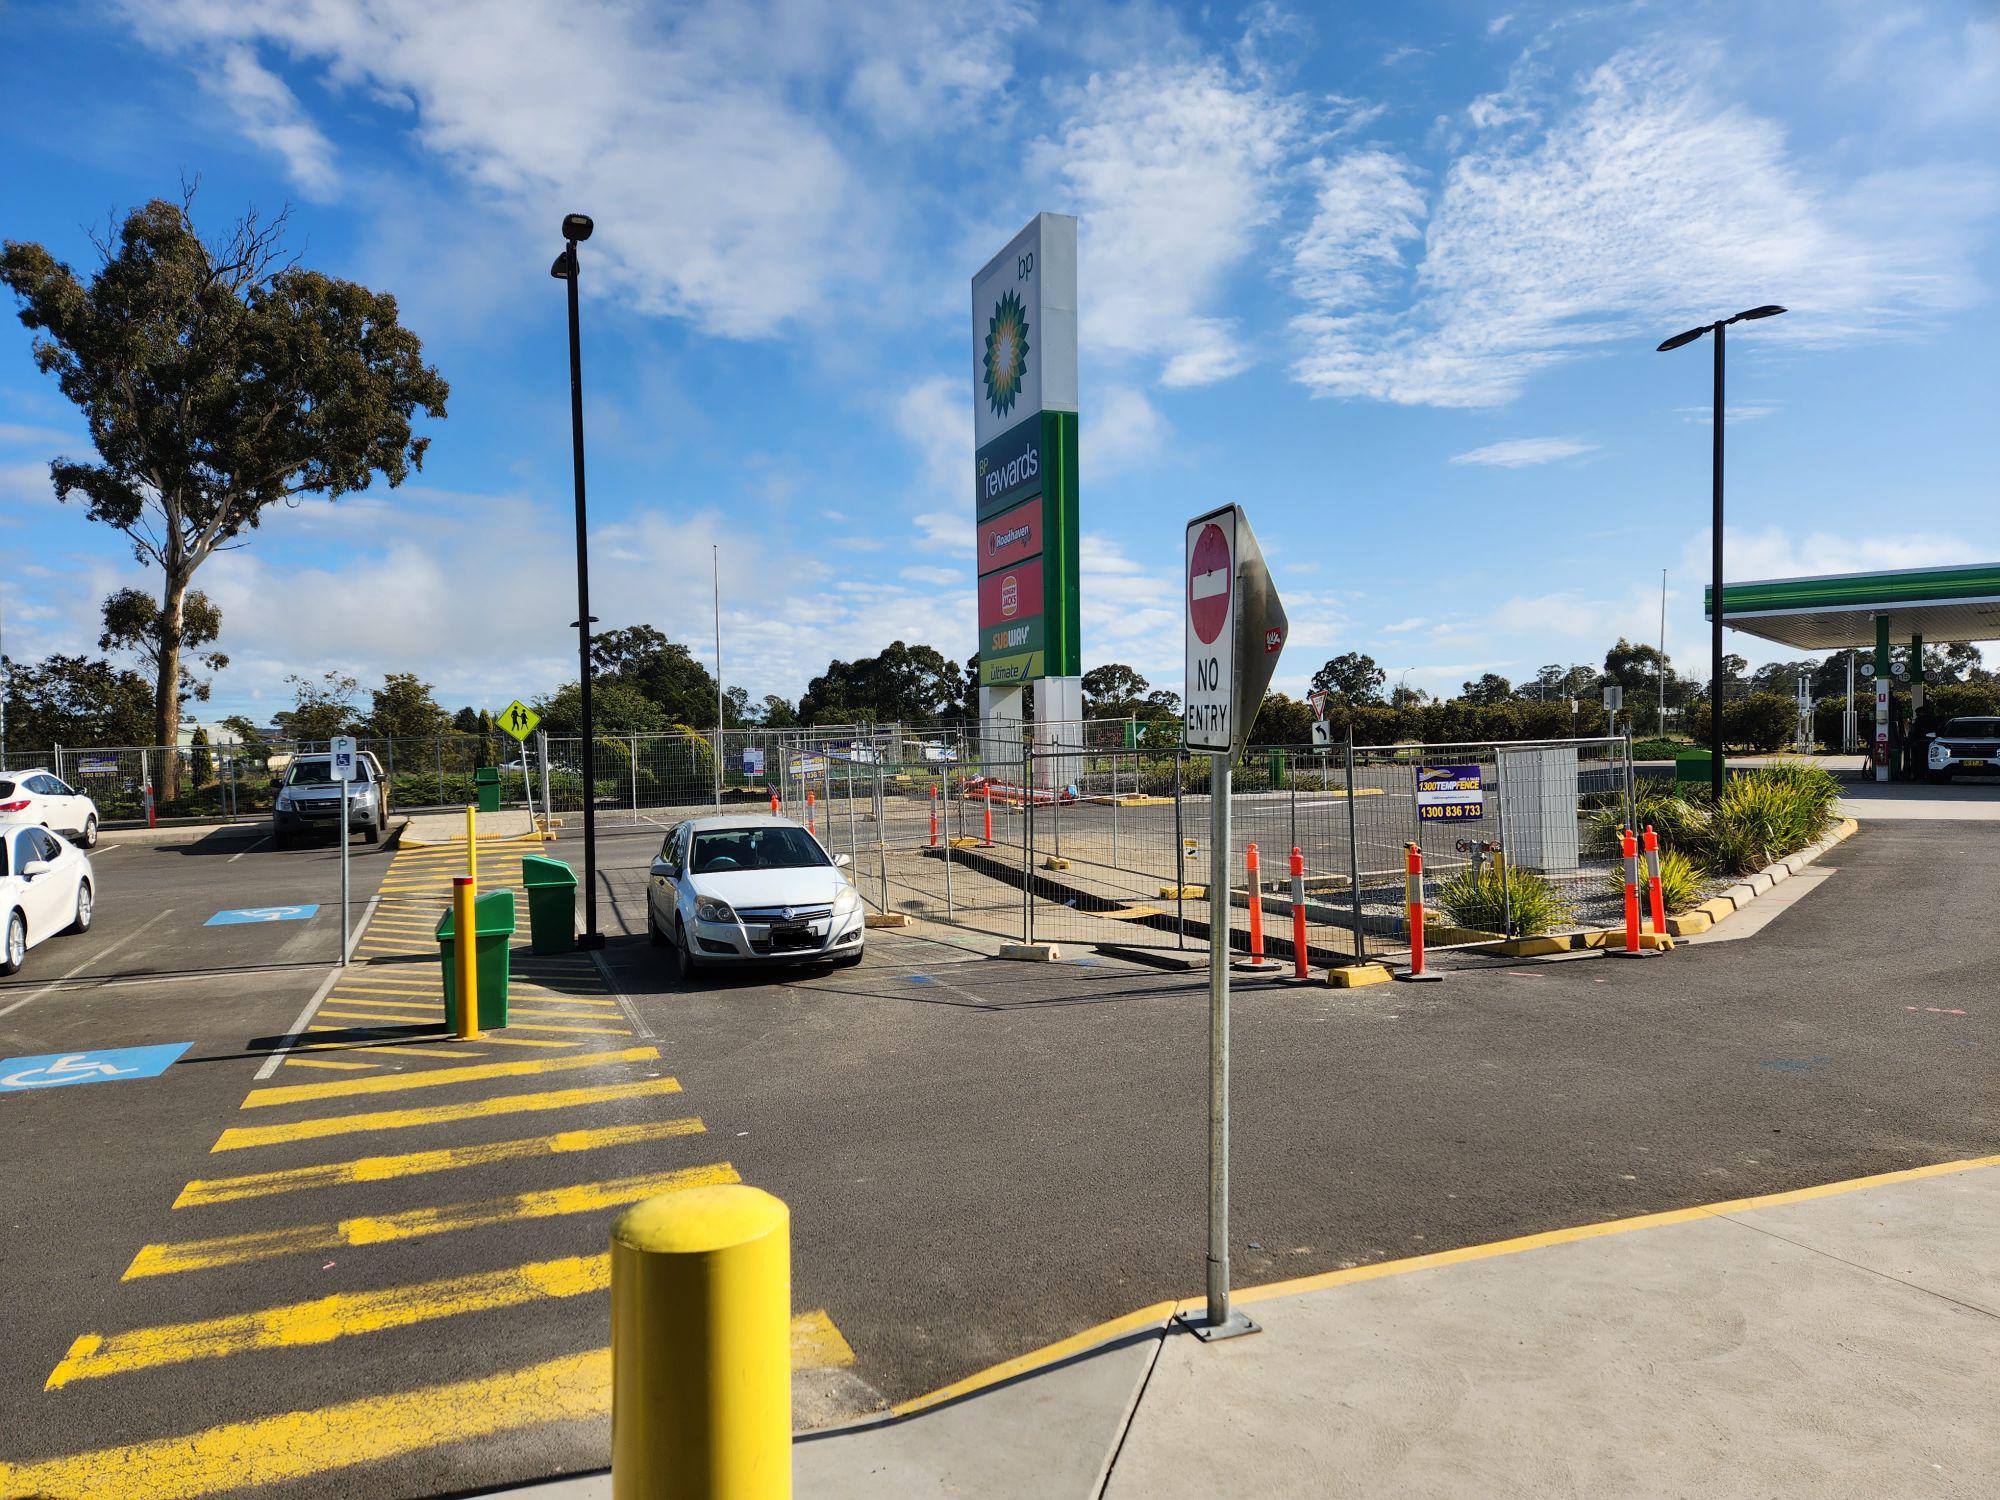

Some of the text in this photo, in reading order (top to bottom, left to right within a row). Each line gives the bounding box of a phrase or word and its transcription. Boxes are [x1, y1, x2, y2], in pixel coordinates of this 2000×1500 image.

[1018, 252, 1033, 281] bp
[985, 443, 1038, 499] rewards
[996, 524, 1029, 549] Roadhaven
[992, 625, 1030, 651] SUBWAY
[1198, 657, 1219, 692] NO
[1189, 704, 1227, 732] ENTRY
[338, 739, 347, 750] P
[1419, 780, 1480, 791] 1300TEMPFENCE
[1421, 804, 1481, 818] 1300 836 733
